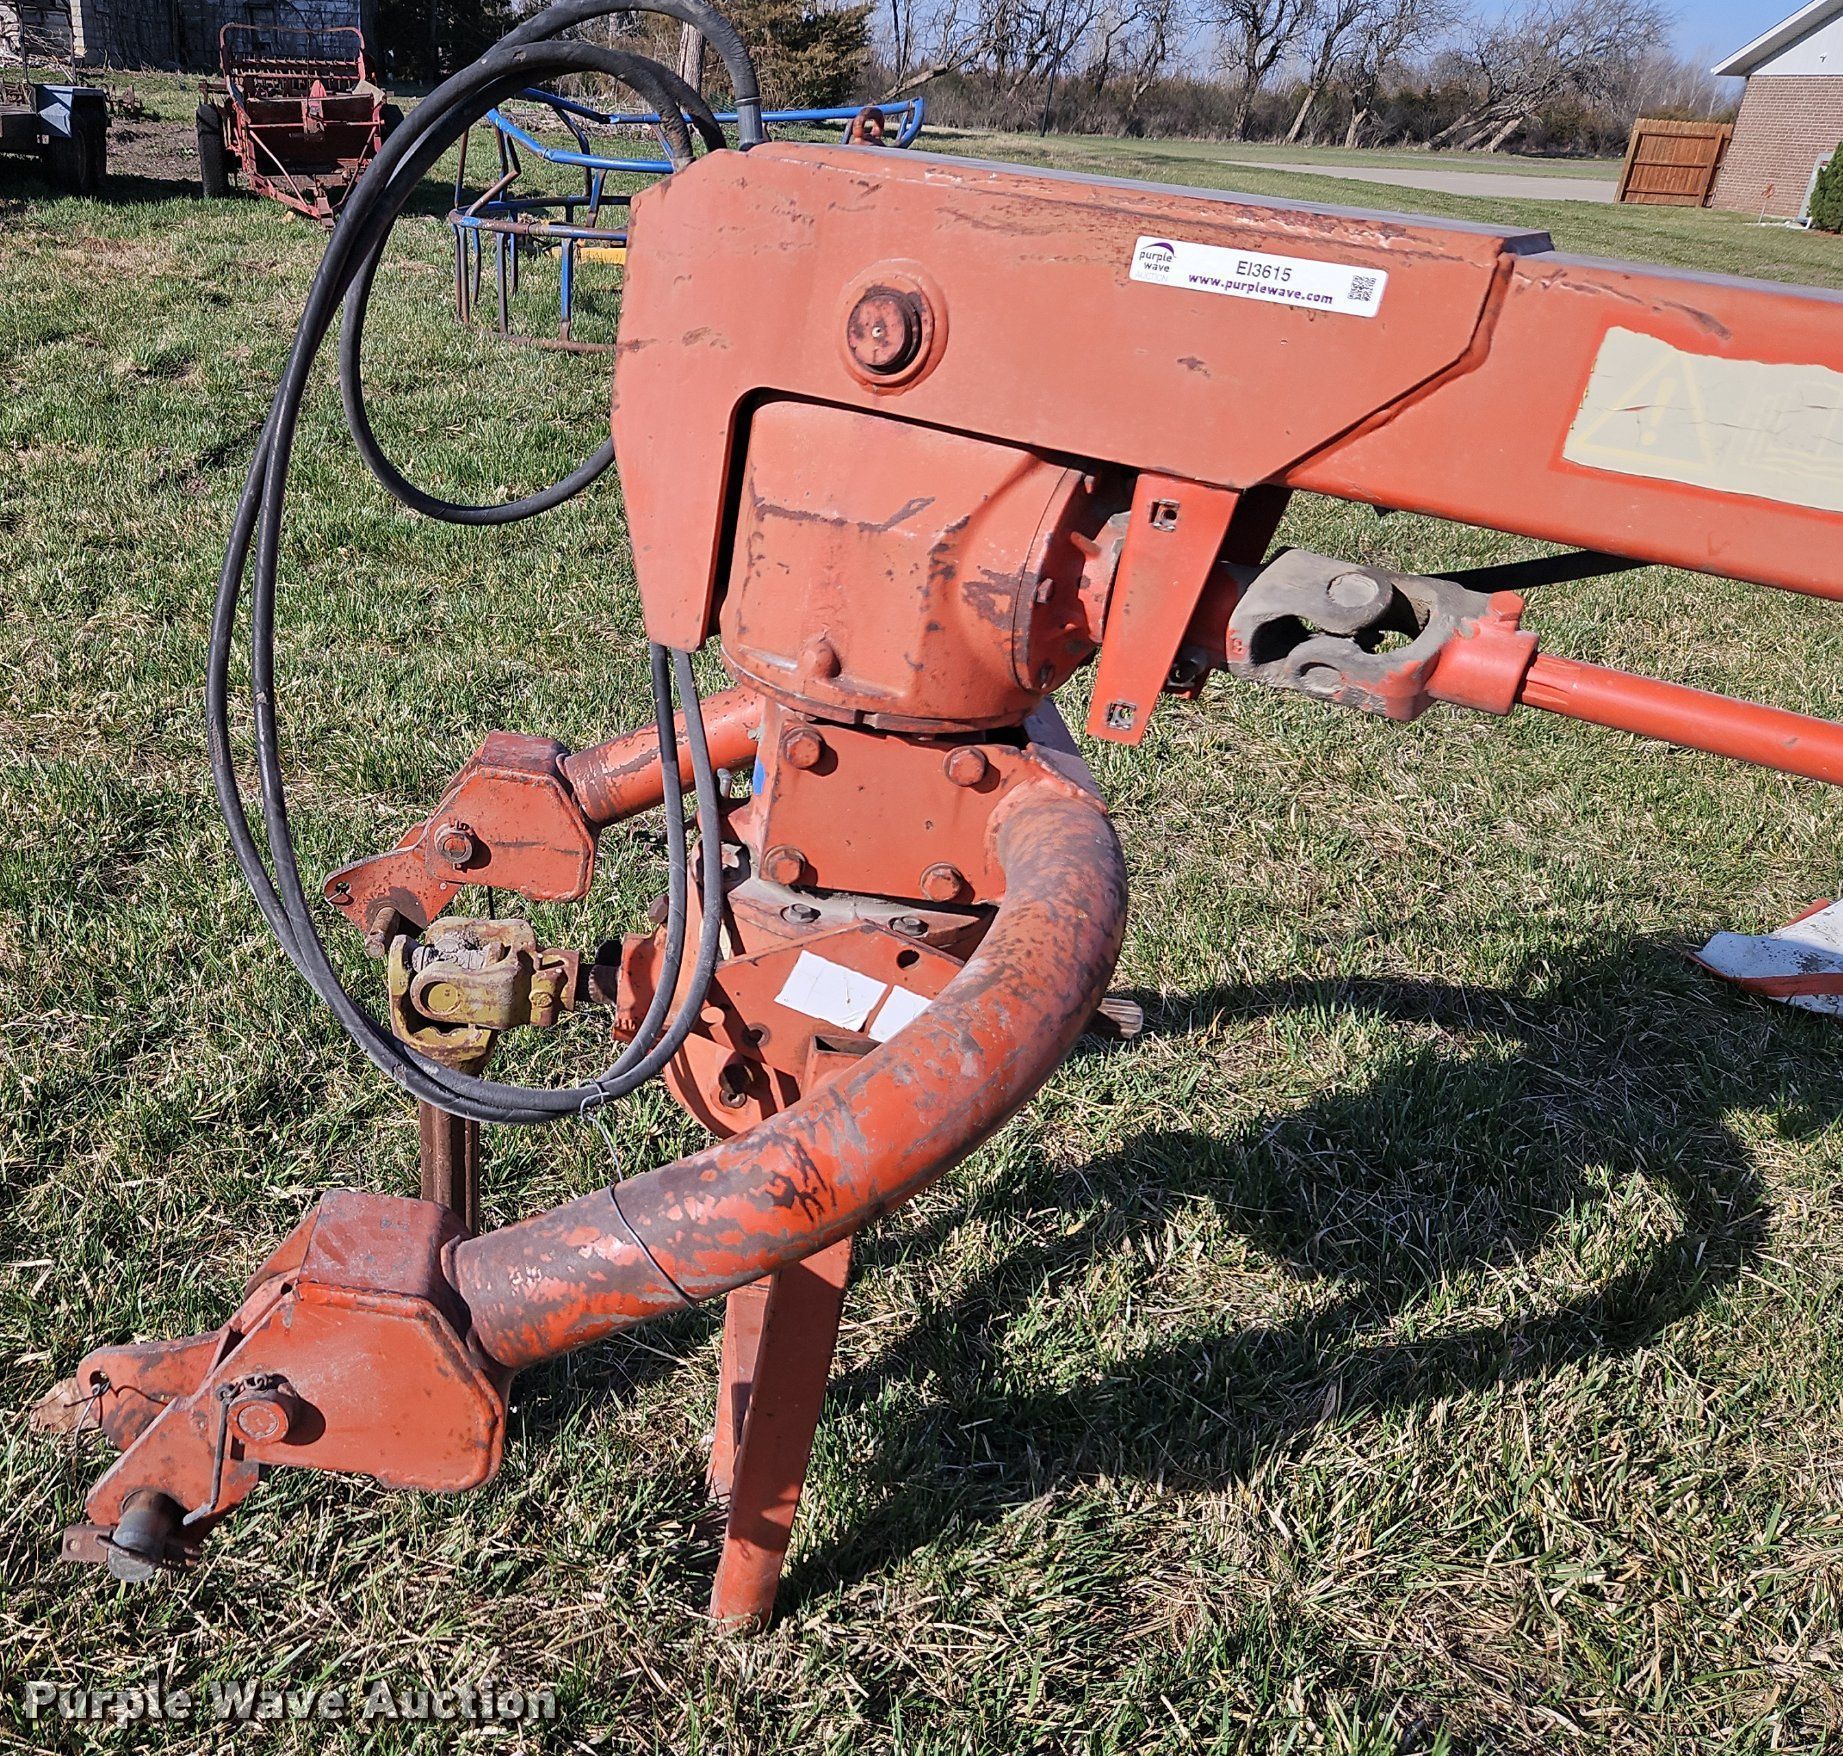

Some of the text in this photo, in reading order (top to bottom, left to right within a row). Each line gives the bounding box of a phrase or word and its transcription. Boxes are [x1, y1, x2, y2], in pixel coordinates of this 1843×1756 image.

[1139, 250, 1173, 263] purple
[1143, 262, 1171, 273] wave
[1235, 261, 1292, 282] EI3615
[1188, 274, 1333, 305] www.purplewave.com
